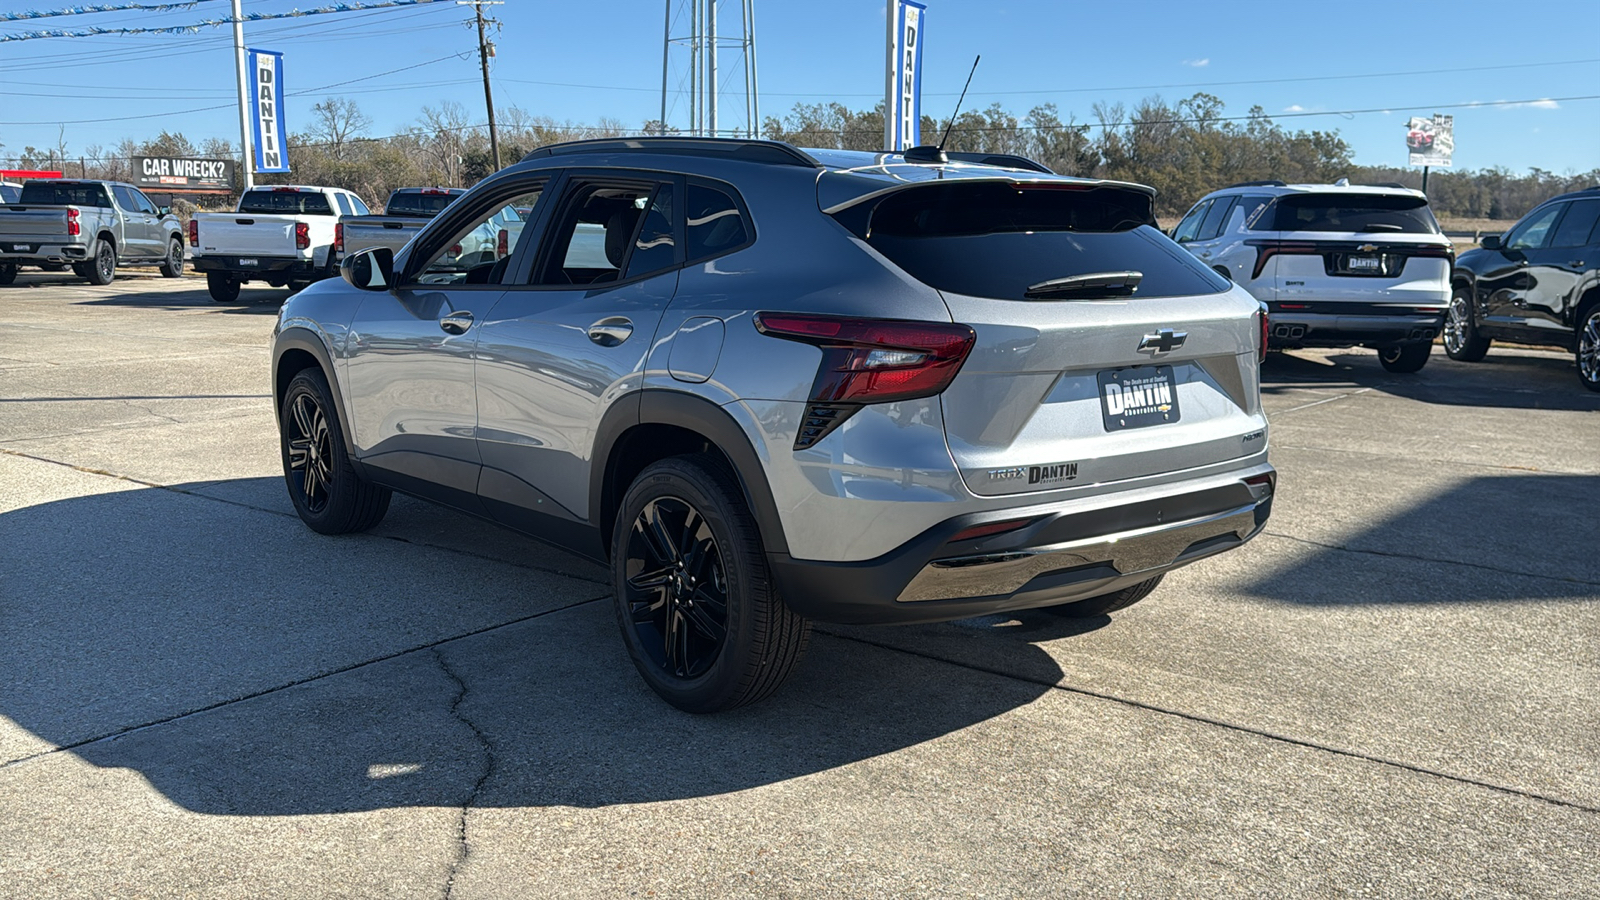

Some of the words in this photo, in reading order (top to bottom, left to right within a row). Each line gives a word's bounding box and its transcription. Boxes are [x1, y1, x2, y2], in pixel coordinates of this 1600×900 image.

[259, 67, 280, 167] DANTIN
[142, 158, 170, 176] CAR
[172, 159, 225, 178] WRECK?
[1349, 257, 1379, 269] DANTIN
[1105, 382, 1172, 415] DANTIN
[987, 466, 1026, 480] TRAX
[1028, 462, 1078, 485] DANTIN
